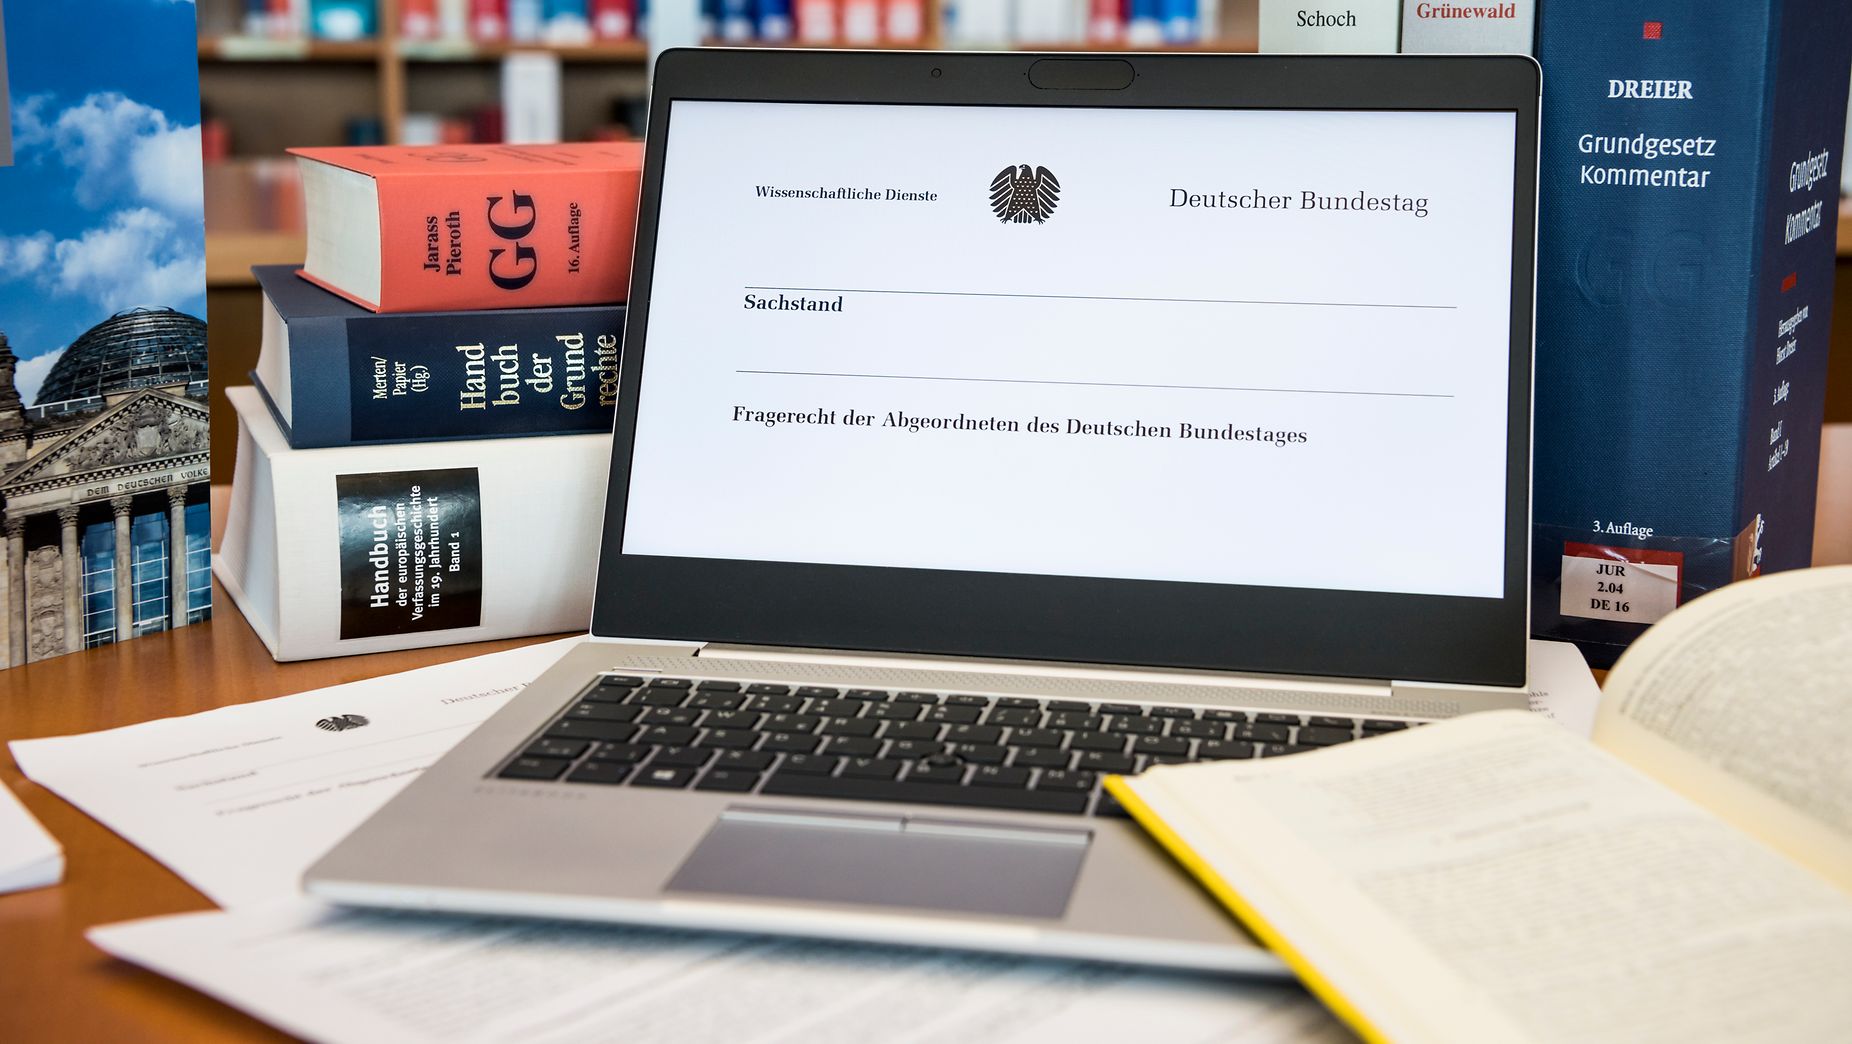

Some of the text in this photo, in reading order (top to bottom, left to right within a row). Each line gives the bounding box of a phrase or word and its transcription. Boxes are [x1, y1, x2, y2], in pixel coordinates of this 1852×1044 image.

[1296, 10, 1357, 27] Schoch
[1416, 2, 1516, 19] Grünewald
[1608, 79, 1694, 100] DREIER
[1578, 133, 1717, 159] Grundgesetz
[1580, 165, 1711, 188] Kommentar
[1789, 147, 1829, 193] Grundgesetz
[755, 185, 938, 202] Wissenschaftliche Dienste
[1169, 188, 1430, 218] Deutscher Bundestag
[446, 210, 462, 276] Pieroth
[486, 189, 538, 290] GG
[567, 202, 582, 274] 16. Auflage
[1784, 200, 1823, 245] Kommentar
[423, 215, 442, 273] Jarass
[743, 294, 844, 313] Sachstand
[370, 356, 387, 400] Merten/
[391, 361, 410, 396] Papier
[409, 365, 431, 392] (Hg.)
[455, 342, 487, 411] Hand
[490, 343, 521, 407] buch
[525, 353, 553, 394] der
[555, 332, 586, 411] Grund
[590, 334, 619, 407] rechte
[732, 405, 1308, 448] Fragerecht der Abgeordneten des Deutschen Bundestages
[87, 467, 209, 497] DEM DEUTSCHEN VOLKE
[1592, 520, 1653, 540] 3. Auflage
[368, 505, 390, 608] Handbuch
[394, 502, 410, 607] der europäischen
[410, 485, 427, 621] Verfassungsgeschichte
[427, 496, 443, 607] im 19. Jahrhundert
[448, 541, 461, 572] Band
[1596, 564, 1625, 577] JUR
[1590, 598, 1630, 613] DE 16
[1597, 581, 1623, 594] 2.04
